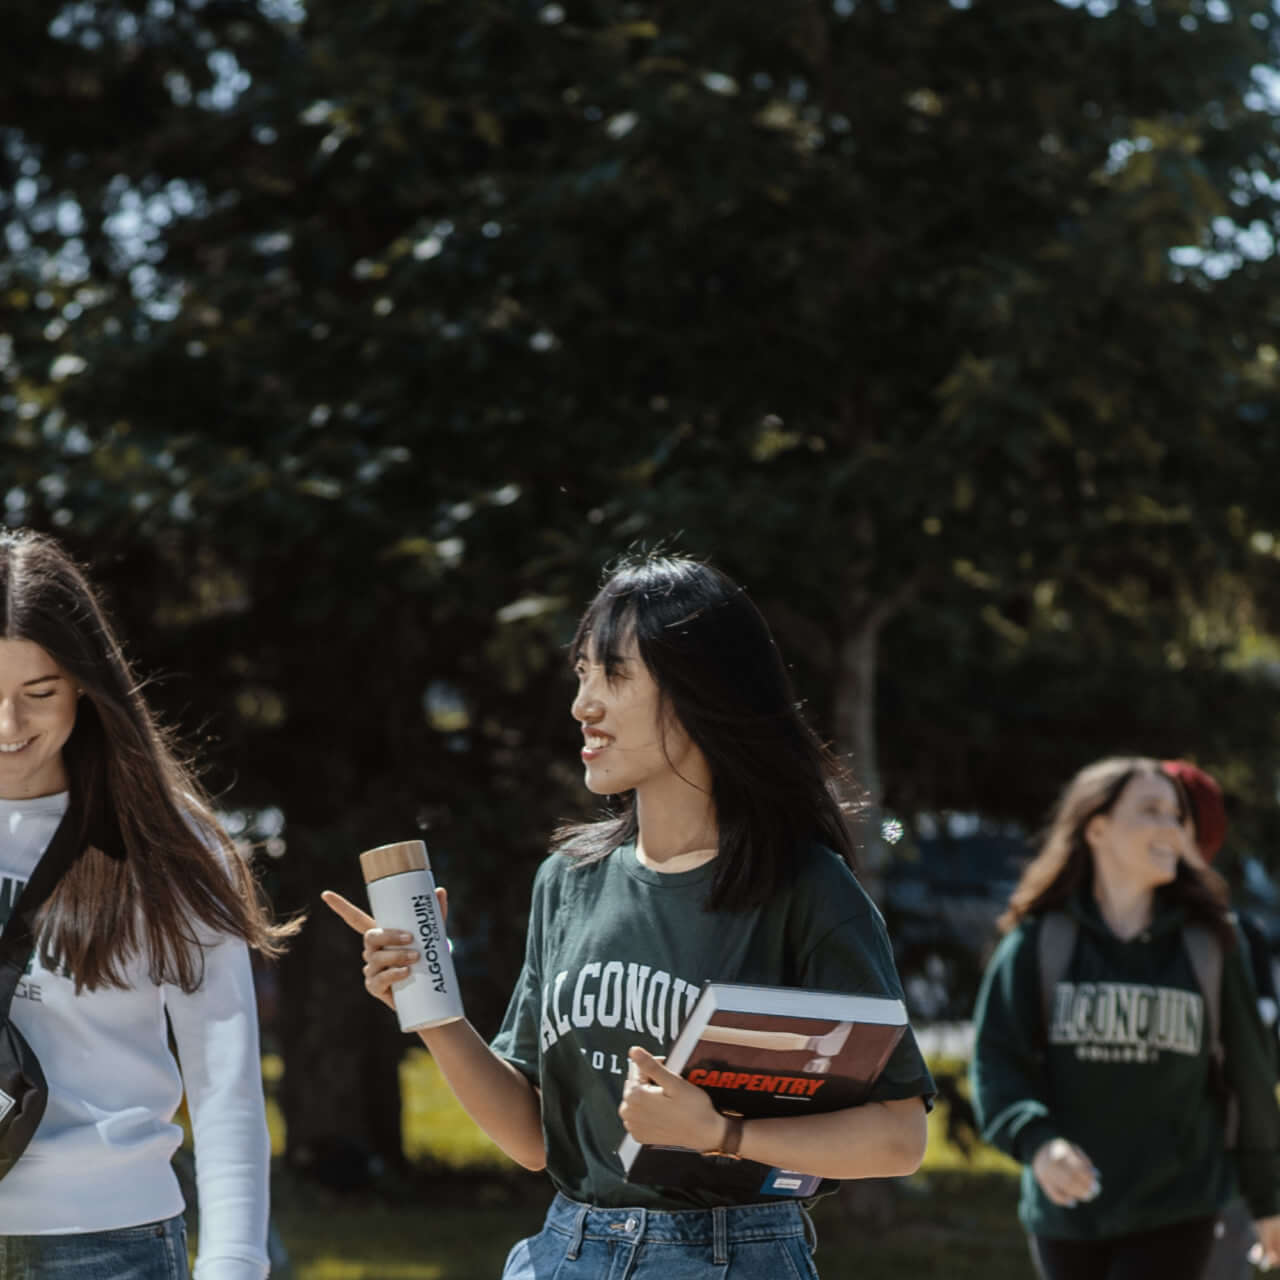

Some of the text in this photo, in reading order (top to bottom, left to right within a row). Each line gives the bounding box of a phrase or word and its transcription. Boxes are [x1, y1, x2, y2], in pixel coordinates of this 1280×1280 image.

[411, 894, 447, 994] ALGONQUIN
[541, 961, 701, 1053] ALGONQU
[688, 1069, 825, 1096] CARPENTRY
